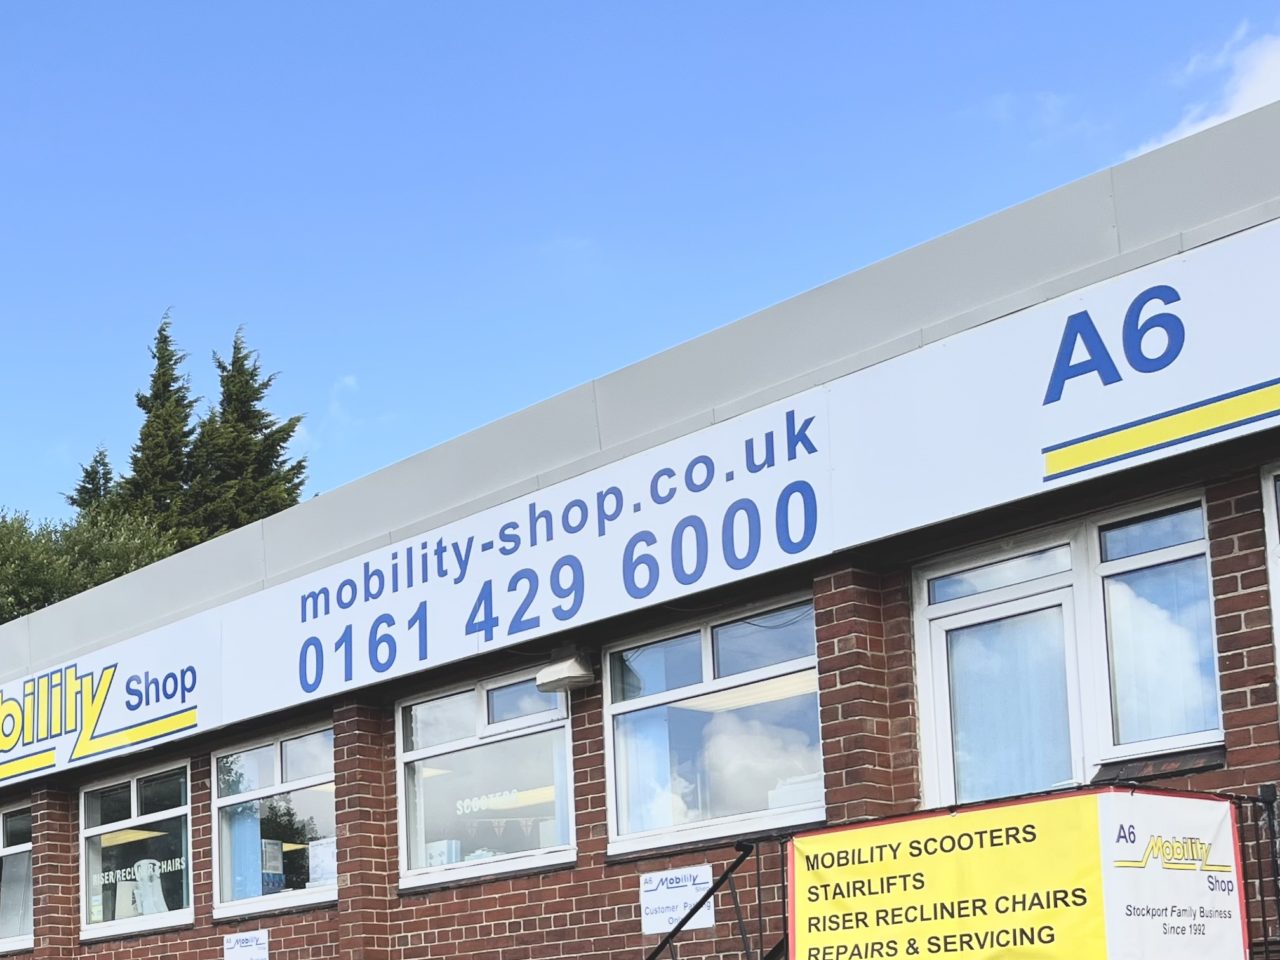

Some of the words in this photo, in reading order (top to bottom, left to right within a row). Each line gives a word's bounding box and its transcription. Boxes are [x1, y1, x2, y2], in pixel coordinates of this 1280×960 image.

[1042, 285, 1185, 406] A6
[299, 409, 819, 622] mobility-shop.co.uk
[298, 600, 428, 693] 0161
[464, 554, 586, 642] 429
[622, 479, 819, 599] 6000
[125, 665, 197, 711] Shop
[805, 842, 902, 871] MOBILITY
[909, 824, 1037, 857] SCOOTERS
[1115, 824, 1136, 844] A6
[1143, 834, 1213, 871] Mobility
[656, 873, 700, 889] Mobility
[807, 872, 925, 902] STAIRLIFTS
[1207, 875, 1234, 896] Shop
[645, 905, 679, 916] Customer
[807, 911, 869, 933] RISER
[876, 898, 988, 926] RECLINER
[995, 887, 1088, 914] CHAIRS
[1125, 904, 1168, 920] Stockport
[1170, 905, 1197, 920] Family
[1199, 907, 1232, 919] Business
[906, 938, 920, 956] &
[927, 925, 1055, 953] SERVICING
[1162, 923, 1186, 935] Since
[1189, 923, 1206, 935] 1992
